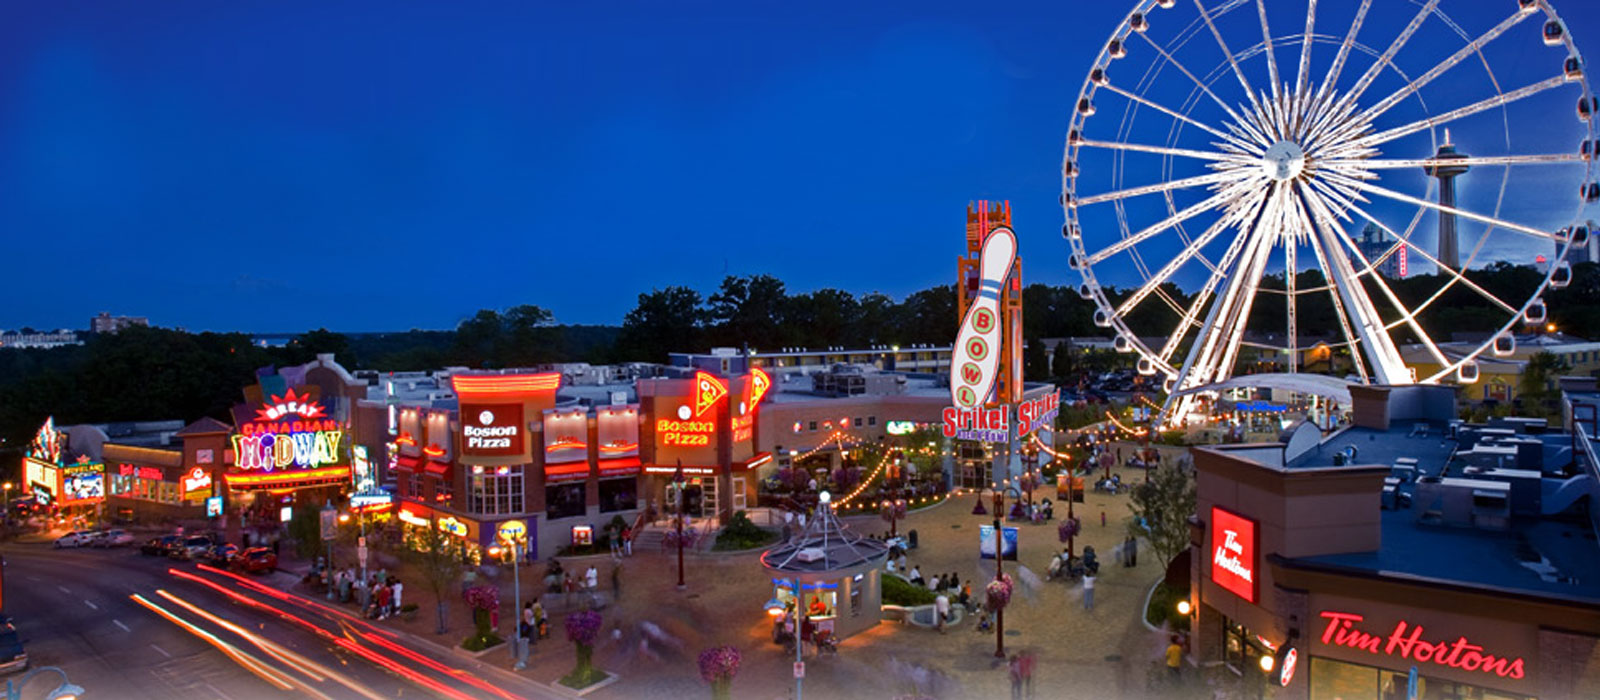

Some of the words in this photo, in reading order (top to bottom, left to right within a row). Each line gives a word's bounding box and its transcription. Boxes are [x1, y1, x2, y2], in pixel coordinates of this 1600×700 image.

[962, 312, 990, 404] BOWL
[265, 401, 317, 419] GREAT
[242, 419, 336, 434] CANADIAN
[657, 419, 714, 432] Boston
[943, 405, 1008, 438] Strike!
[464, 425, 517, 437] Boston
[663, 432, 708, 445] Pizza
[468, 437, 511, 448] Pizza
[1224, 530, 1242, 555] Tim
[1214, 546, 1253, 583] Hortons
[1320, 611, 1382, 654] Tim
[1385, 620, 1525, 680] Hortons
